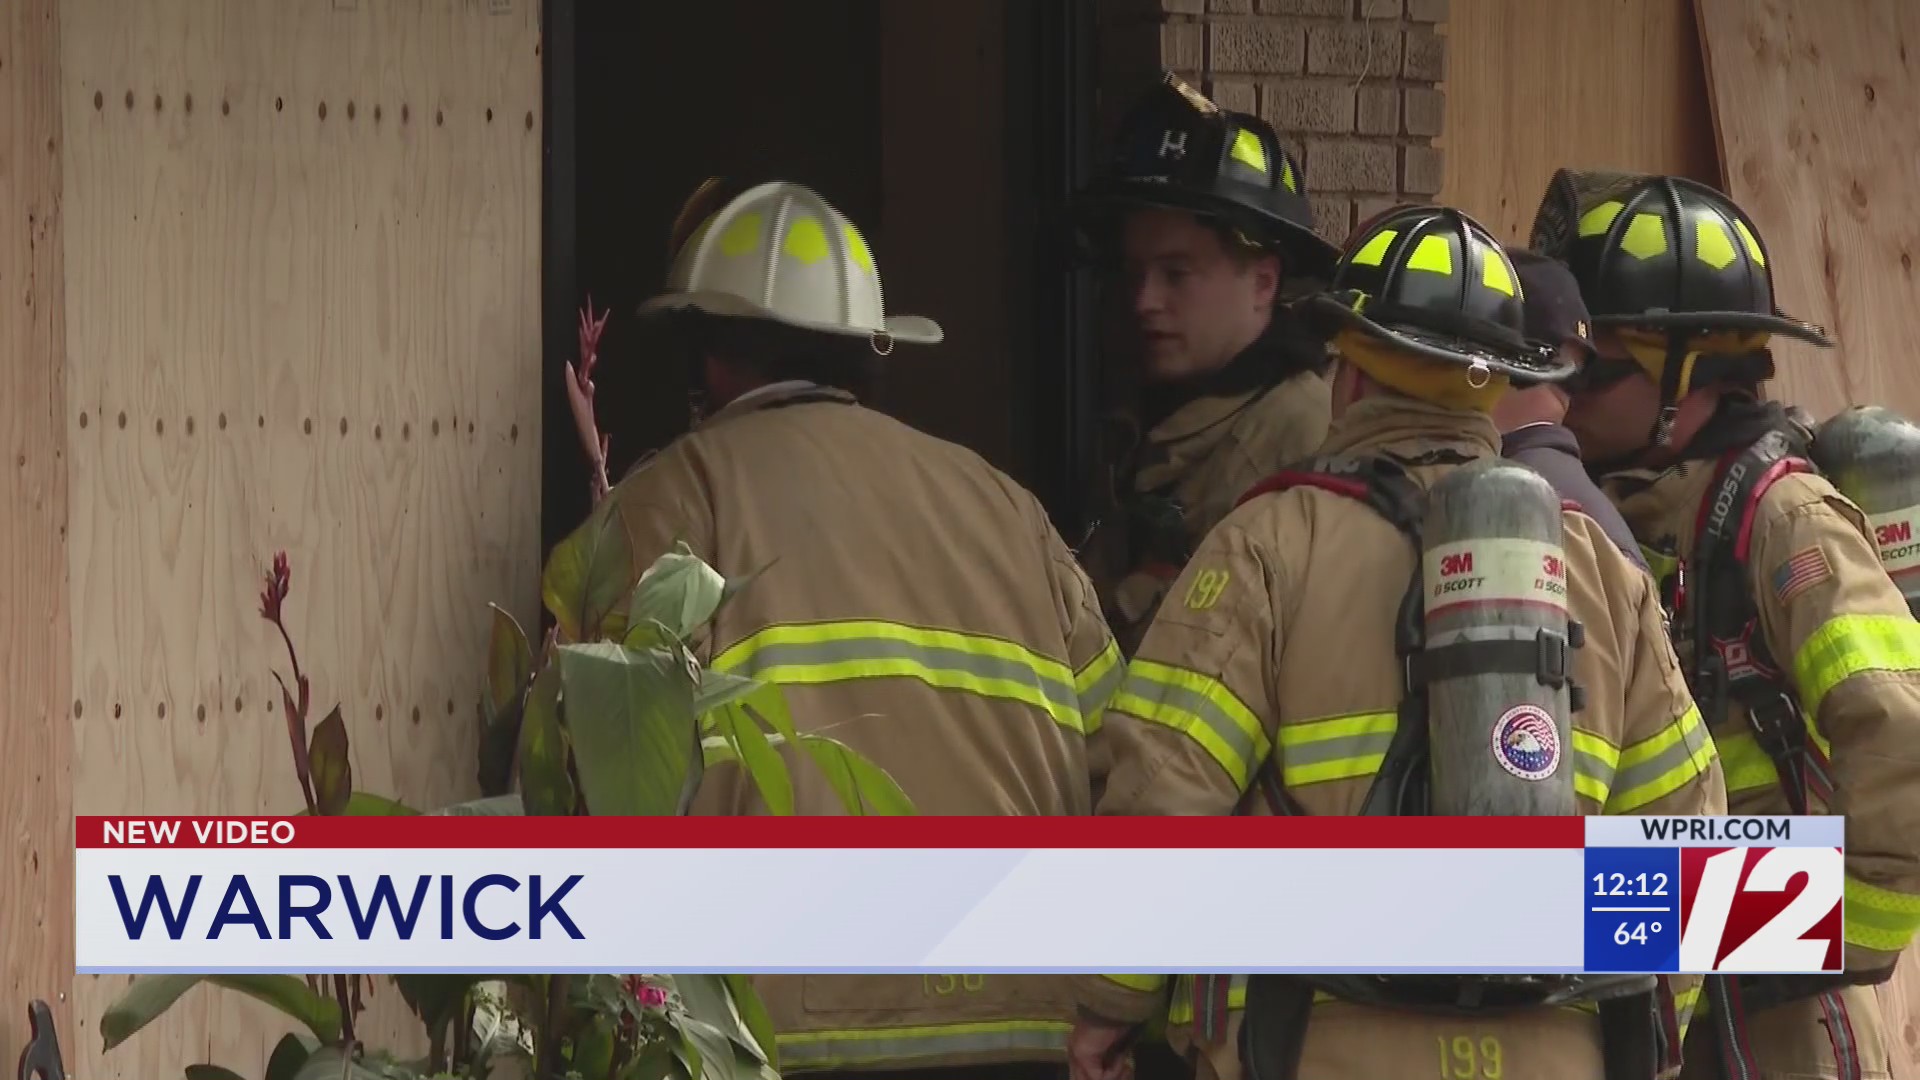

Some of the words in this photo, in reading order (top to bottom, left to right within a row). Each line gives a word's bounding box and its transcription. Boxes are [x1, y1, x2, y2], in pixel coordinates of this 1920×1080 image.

[1875, 520, 1911, 546] 3M
[1440, 552, 1473, 576] 3M
[1443, 577, 1484, 594] SCOTT
[1437, 1035, 1502, 1079] 199
